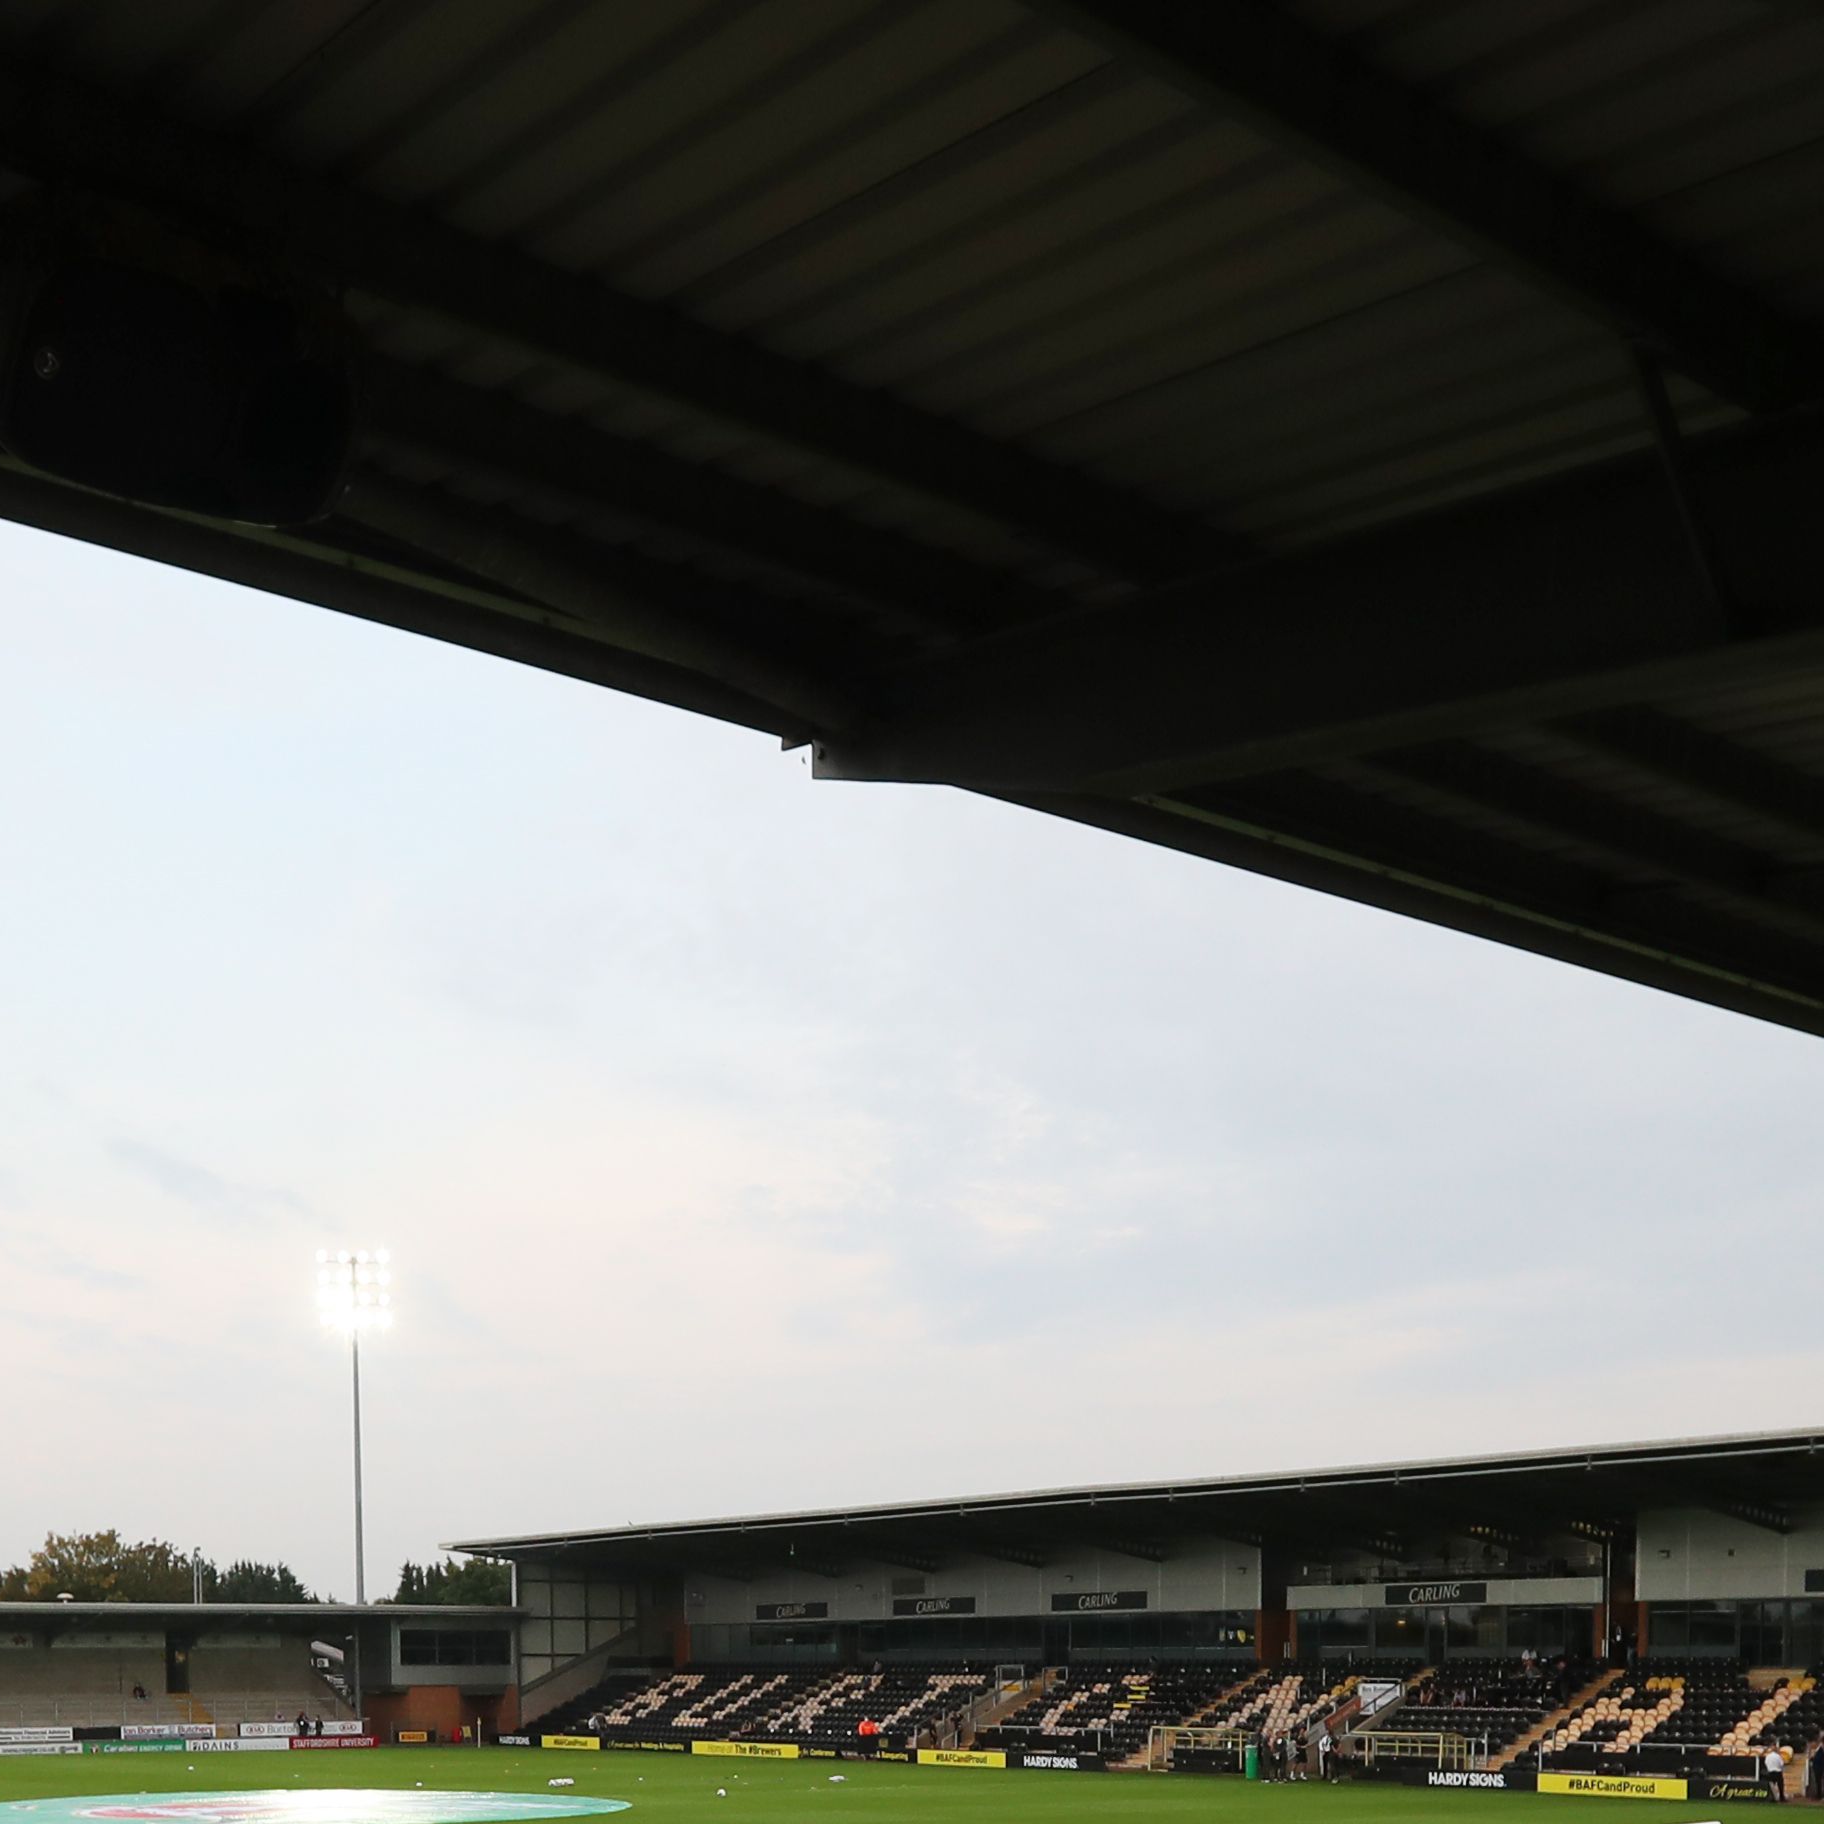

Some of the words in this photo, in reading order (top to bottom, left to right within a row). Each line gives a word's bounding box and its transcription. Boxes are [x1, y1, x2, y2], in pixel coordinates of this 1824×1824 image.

[1409, 1583, 1460, 1602] CARLING
[916, 1598, 951, 1614] CARLING
[1078, 1592, 1118, 1610] CARLING
[202, 1740, 240, 1750] DAINS
[1023, 1755, 1052, 1767] HARDY
[1053, 1756, 1078, 1769] SIGNS
[1428, 1771, 1470, 1787] HARDY
[1471, 1772, 1505, 1788] SIGNS
[1568, 1778, 1655, 1794] #BAFCandProud
